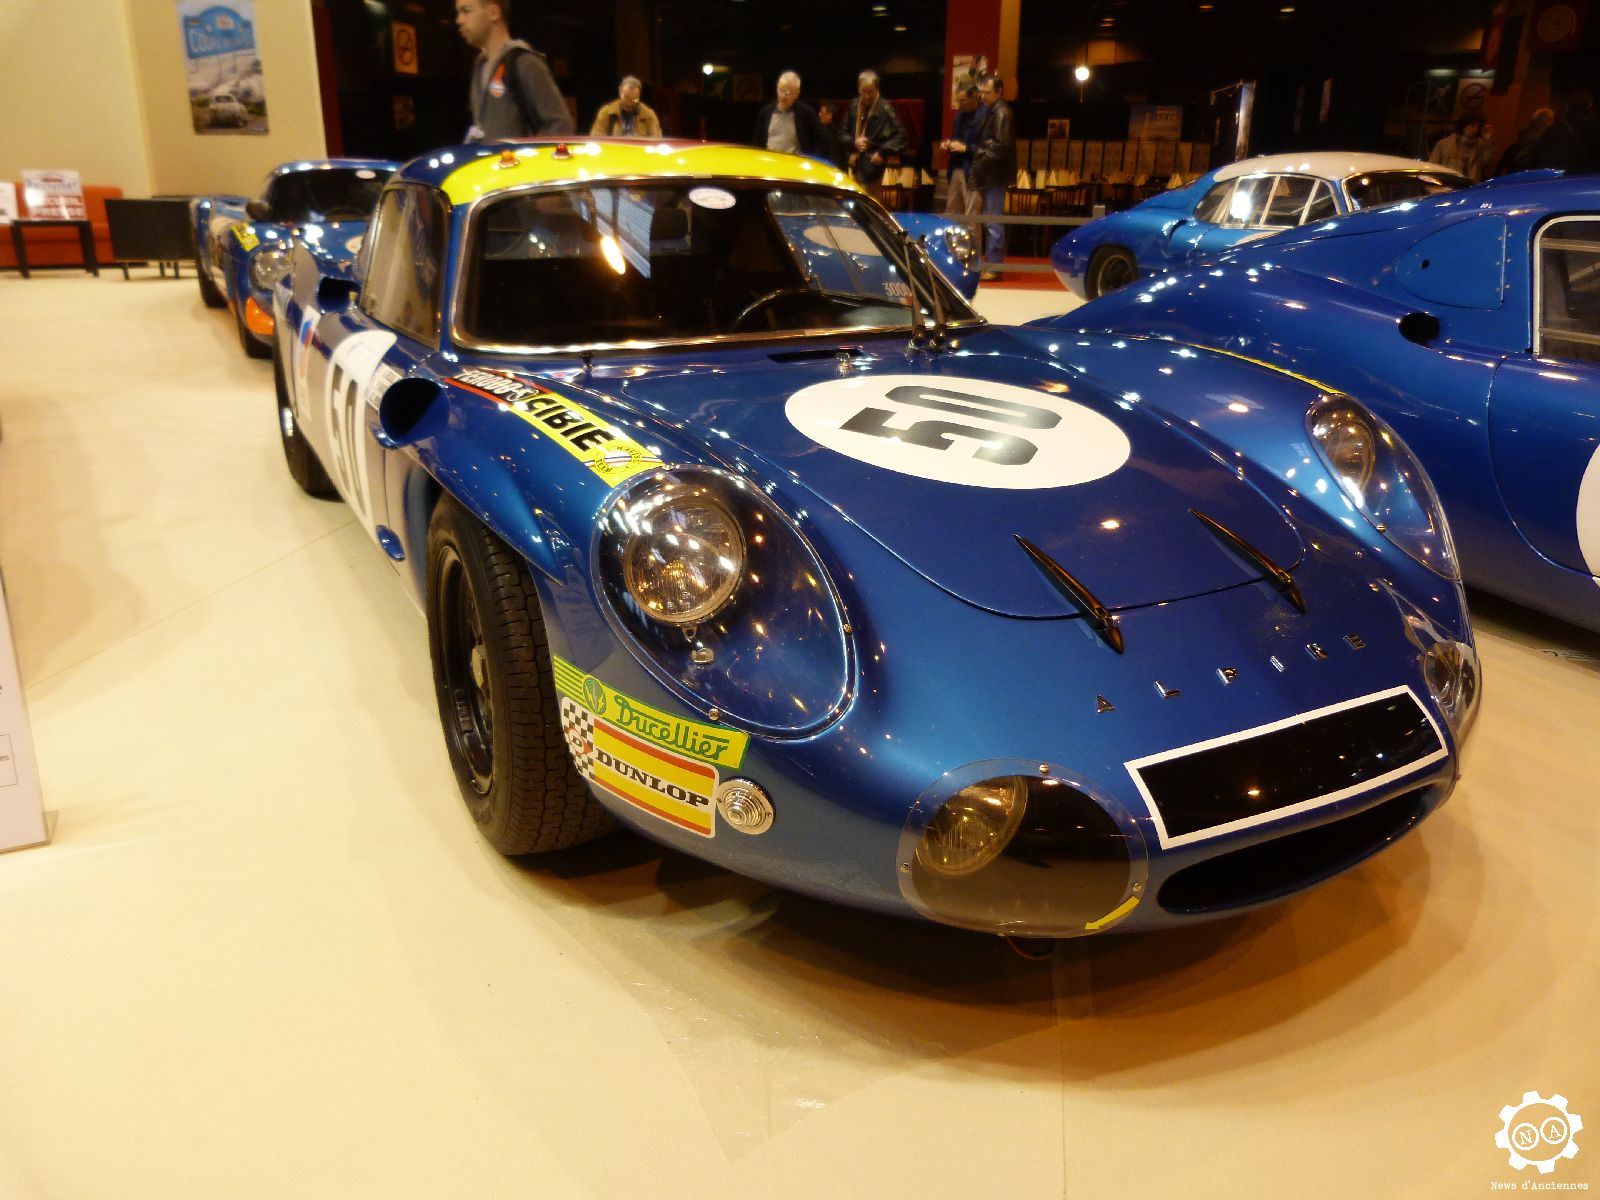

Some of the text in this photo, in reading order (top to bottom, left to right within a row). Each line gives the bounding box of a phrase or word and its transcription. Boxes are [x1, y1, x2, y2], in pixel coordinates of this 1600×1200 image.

[839, 386, 1063, 466] 50
[614, 694, 730, 761] Ducellier
[595, 747, 709, 808] DUNLOP
